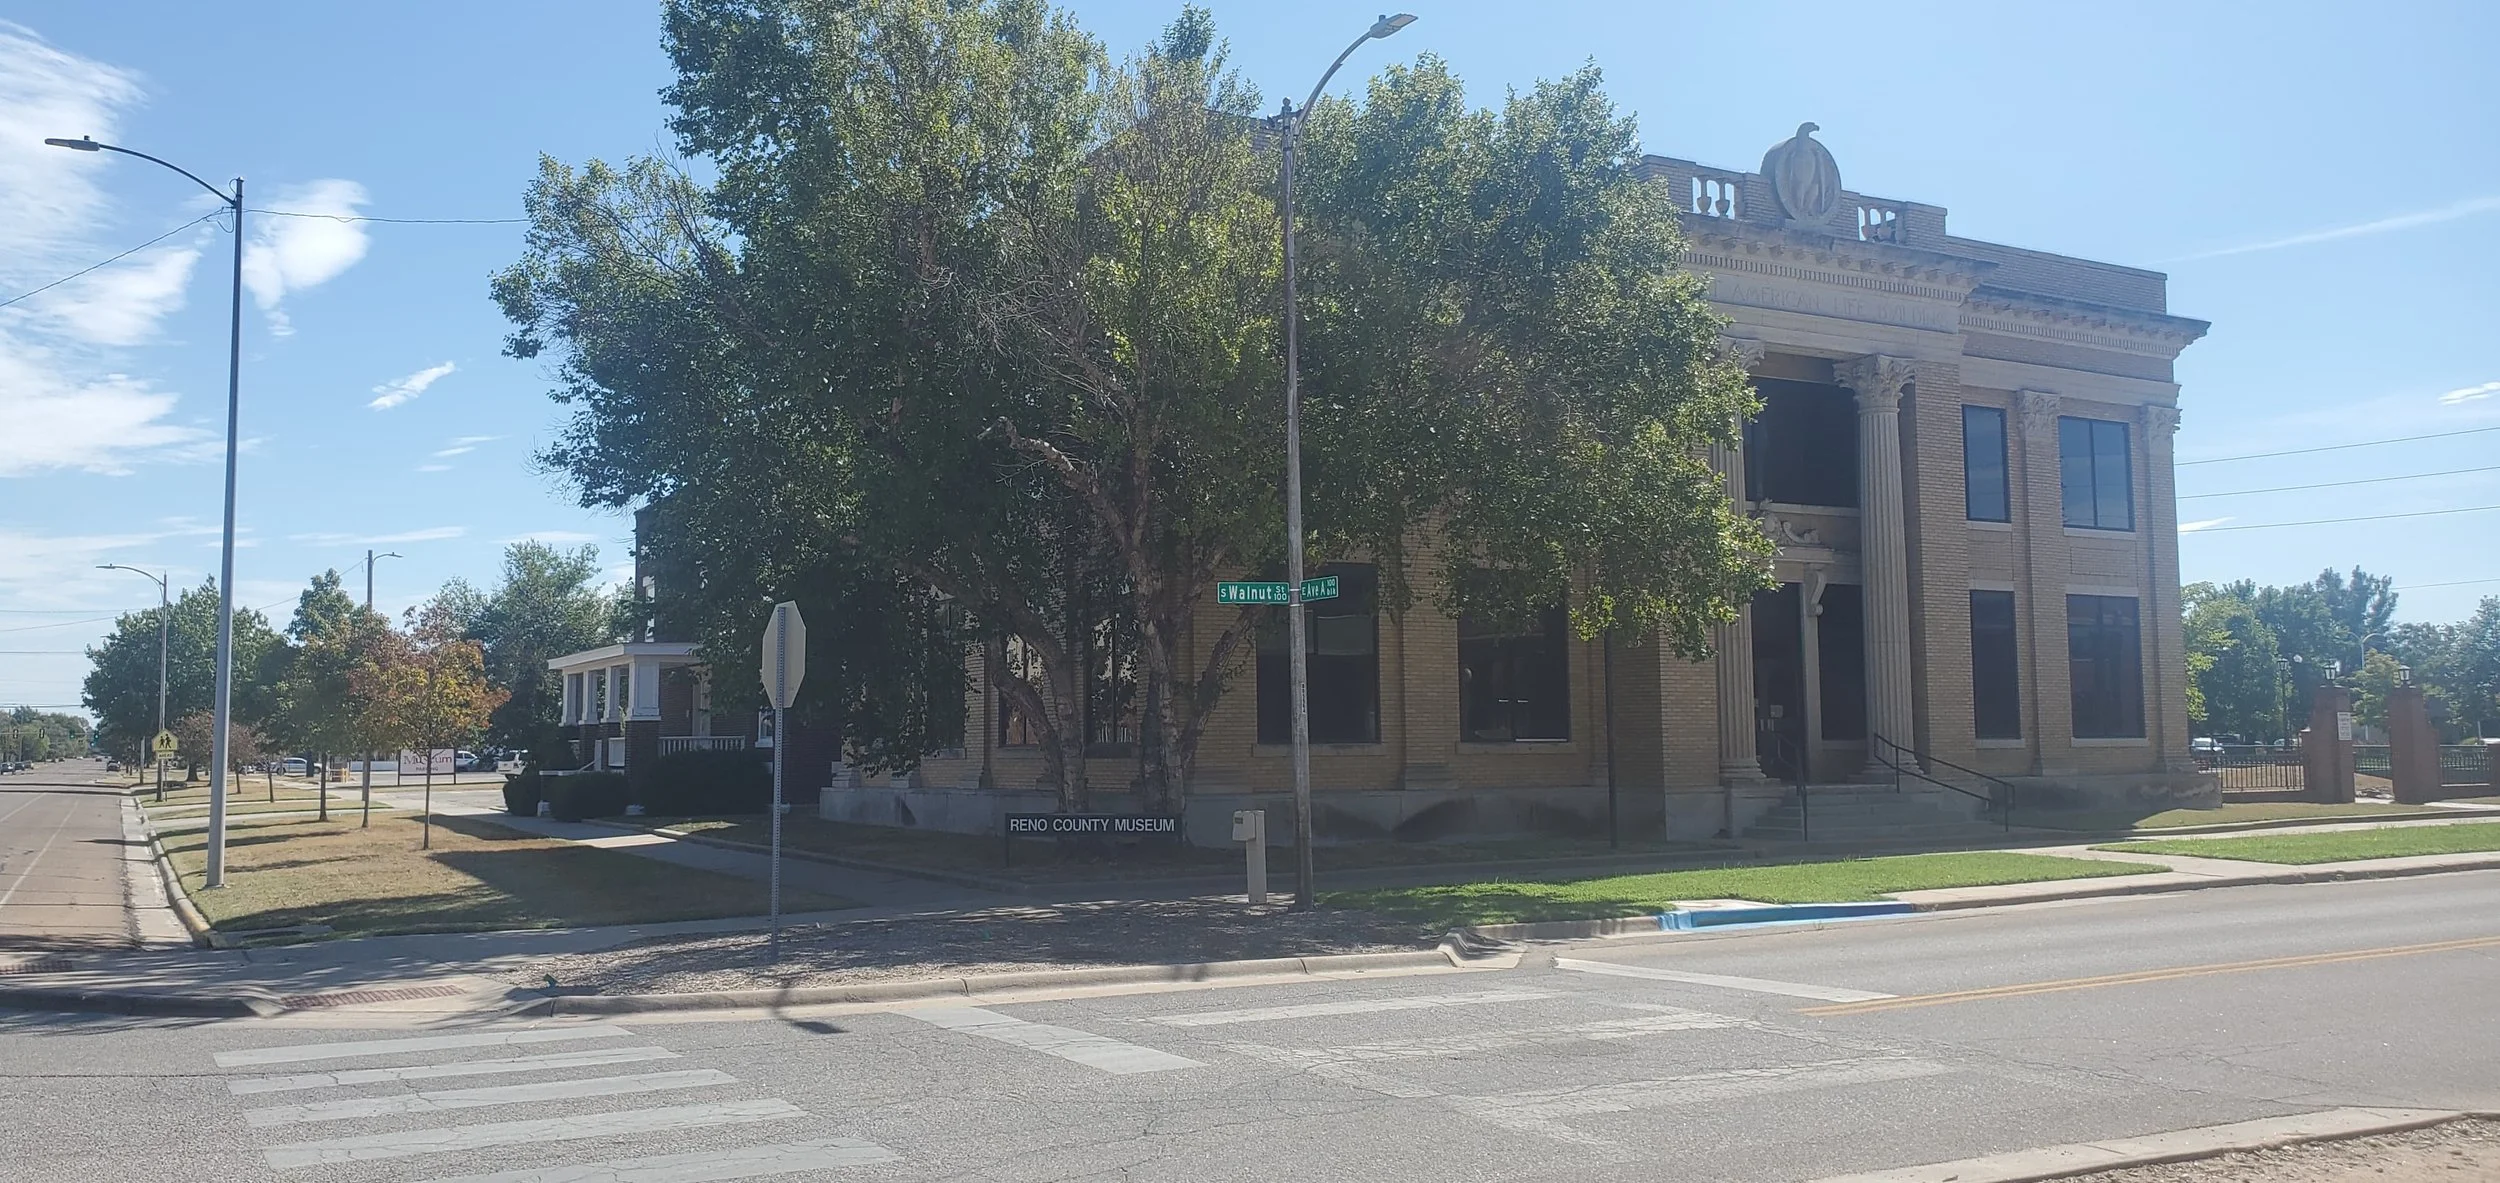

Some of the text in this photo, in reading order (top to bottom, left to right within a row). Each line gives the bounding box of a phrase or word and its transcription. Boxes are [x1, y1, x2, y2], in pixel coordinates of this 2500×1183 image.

[1220, 585, 1272, 600] S Walnut
[1276, 585, 1284, 593] St
[1302, 580, 1326, 597] E Ave A
[1274, 593, 1287, 601] 100
[1010, 818, 1175, 832] RENO COUNTY MUSEUM
